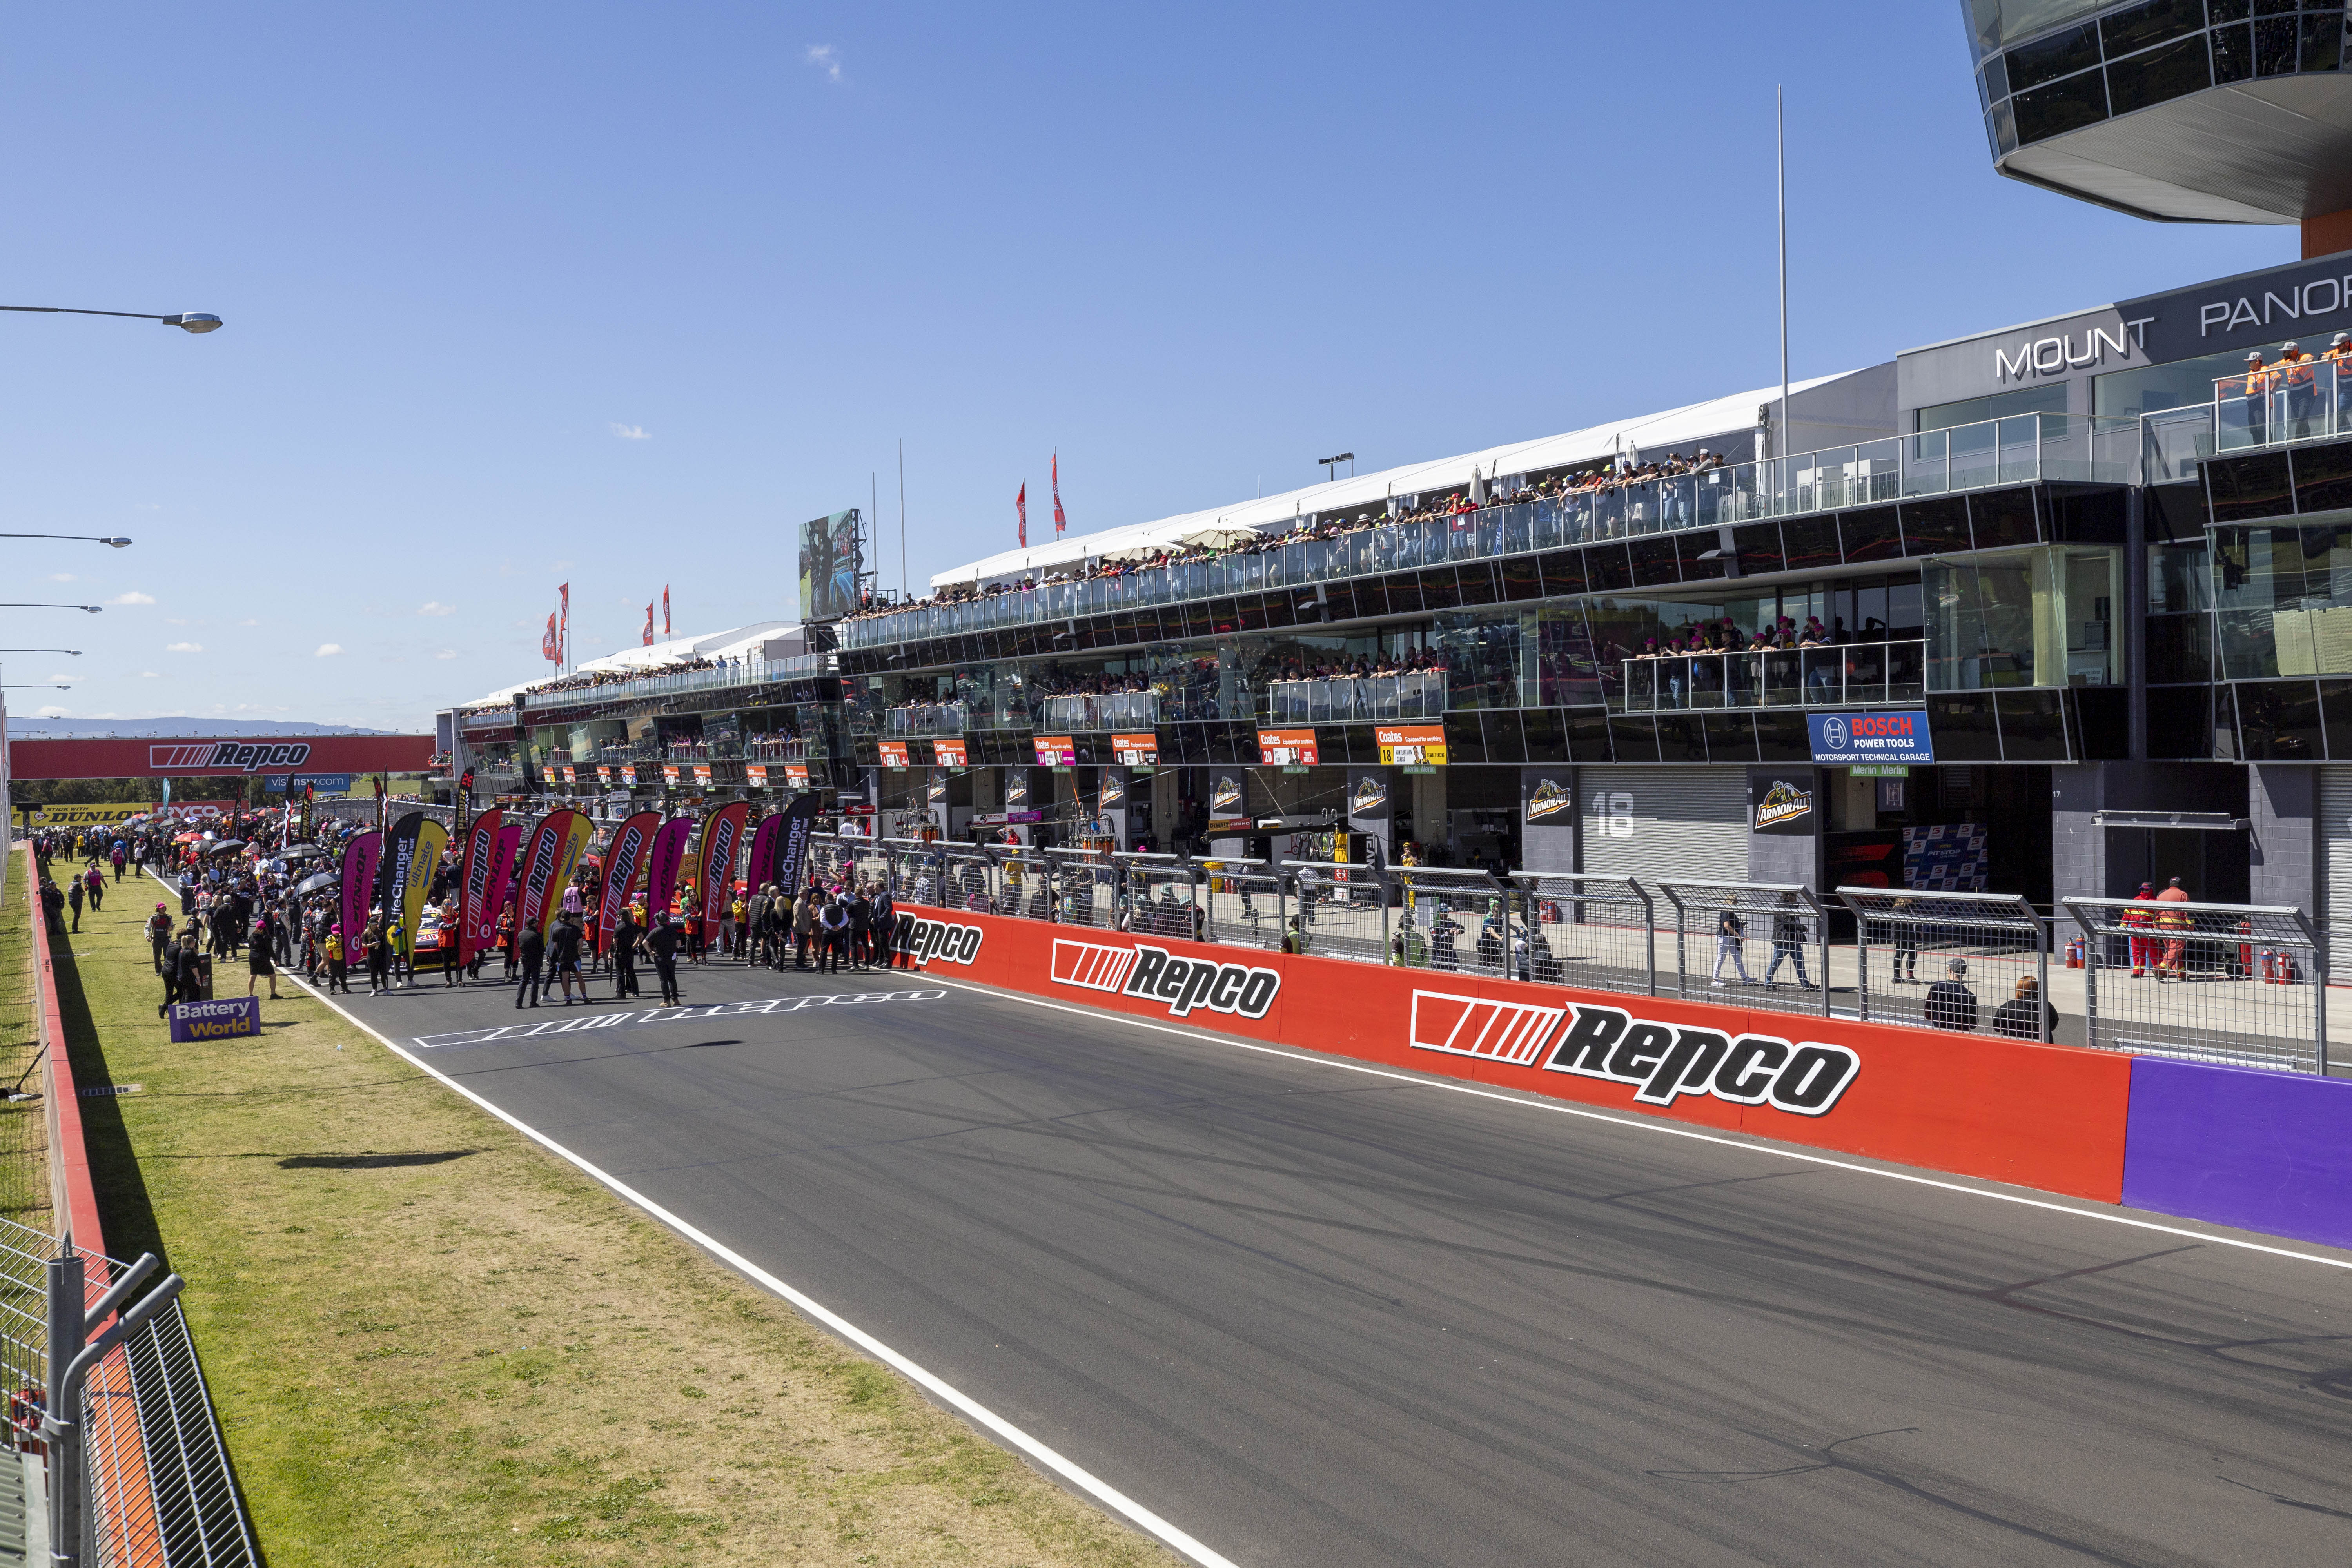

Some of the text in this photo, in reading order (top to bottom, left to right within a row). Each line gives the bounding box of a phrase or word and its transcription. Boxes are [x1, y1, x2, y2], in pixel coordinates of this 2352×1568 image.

[1996, 274, 2352, 377] MOUNT PANO
[1851, 717, 1913, 736] BOSCH
[1036, 740, 1050, 749] Coates
[1114, 738, 1129, 748] Coates
[1261, 734, 1280, 745] Coates
[1379, 731, 1403, 742] Coates
[1854, 739, 1915, 748] POWER TOOLS
[209, 741, 310, 771] Repco
[935, 743, 947, 751] Coates
[1264, 750, 1272, 762] 20
[1383, 749, 1392, 762] 18
[937, 755, 943, 764] 96
[1038, 754, 1044, 764] 14
[1118, 752, 1122, 763] 8
[1853, 765, 1905, 775] Merlin Merlin
[272, 777, 344, 786] visinsw.com
[462, 773, 474, 787] 26
[158, 805, 219, 818] RYCO
[1592, 792, 1633, 838] 18
[609, 826, 642, 895] Repco
[709, 818, 734, 886] Repco
[780, 817, 802, 895] LifeChanger
[468, 828, 490, 899] Repco
[526, 827, 558, 897] Repco
[660, 829, 677, 900] DUNLOP
[354, 846, 367, 922] DUNLOP
[390, 837, 408, 922] LifeChanger
[486, 838, 506, 913] DUNLOP
[566, 895, 577, 903] 80
[890, 910, 983, 965] Repco
[1122, 943, 1281, 1019] Repco
[176, 1002, 250, 1020] Battery
[189, 1017, 250, 1037] World
[1543, 1002, 1860, 1116] Repco
